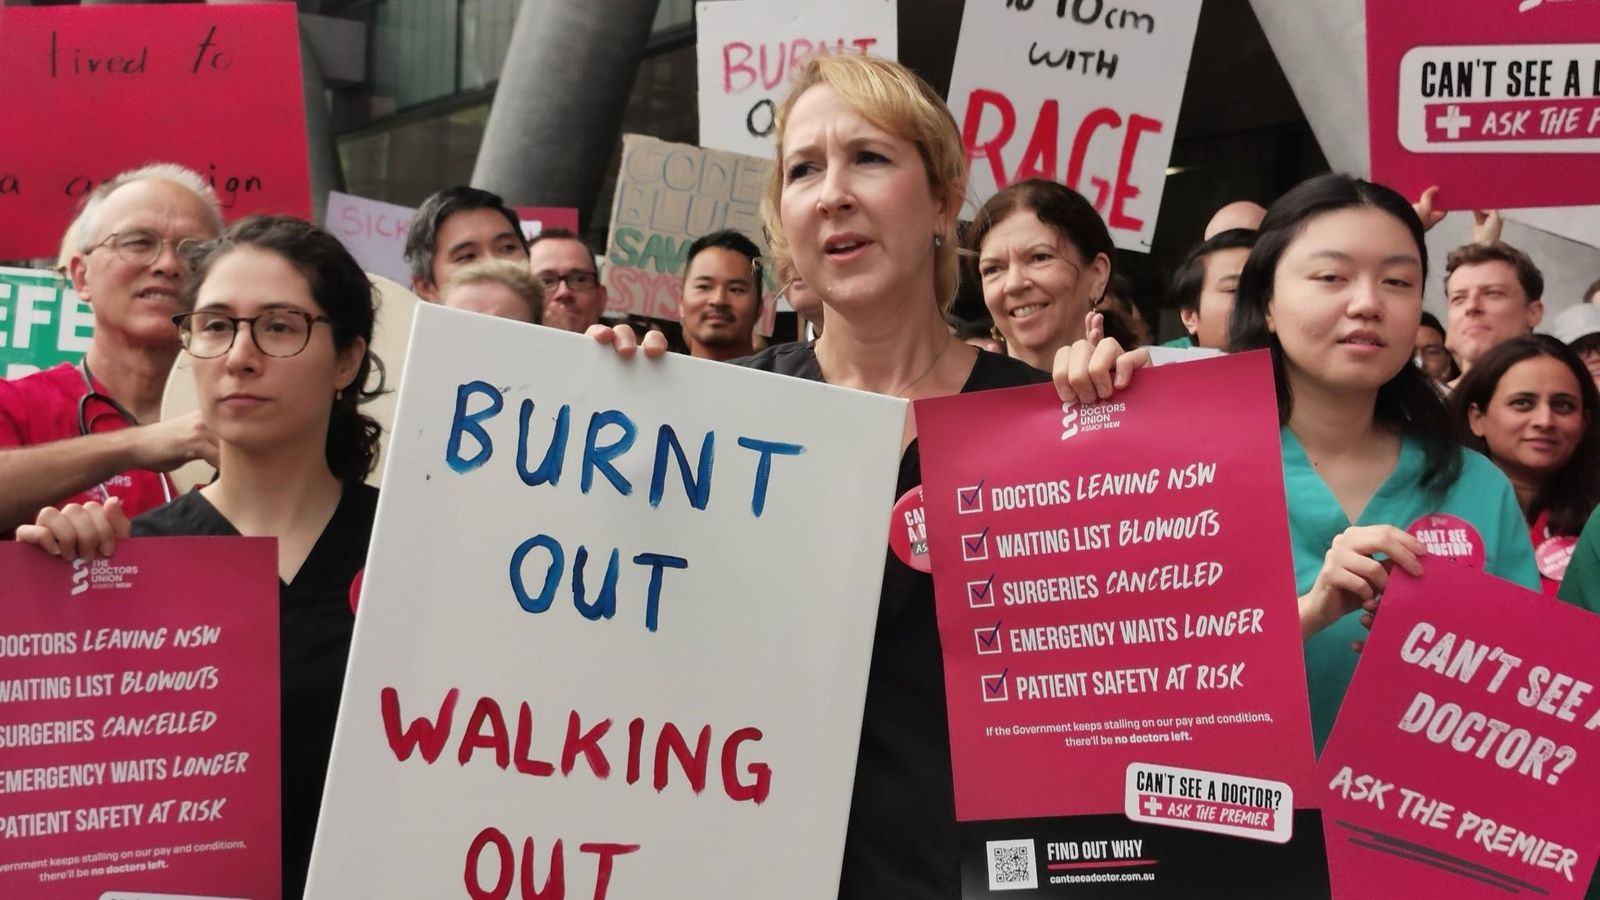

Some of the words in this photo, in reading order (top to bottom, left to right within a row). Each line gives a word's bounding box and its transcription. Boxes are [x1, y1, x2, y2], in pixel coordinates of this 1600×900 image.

[193, 25, 230, 73] to
[1029, 42, 1119, 79] WITH
[1421, 59, 1497, 97] CAN'T
[1506, 60, 1553, 97] SEE
[1564, 60, 1580, 96] A
[1481, 109, 1531, 136] ASK
[1540, 107, 1583, 135] THE
[626, 150, 766, 206] CODE
[962, 88, 1163, 232] RAGE
[616, 182, 757, 238] BLUE
[609, 227, 694, 274] SAV
[1080, 403, 1126, 417] DOCTORS
[1080, 414, 1110, 425] UNION
[446, 380, 806, 518] BURNT
[991, 481, 1071, 512] DOCTORS
[1076, 468, 1161, 501] LEAVING
[1168, 462, 1217, 491] NSW
[996, 531, 1070, 559] WAITING
[1074, 525, 1111, 551] LIST
[1119, 510, 1220, 547] BLOWOUTS
[1448, 529, 1467, 543] SEE
[91, 566, 138, 575] DOCTORS
[91, 575, 123, 583] UNION
[509, 534, 688, 632] OUT
[1003, 575, 1098, 606] SURGERIES
[1106, 562, 1224, 594] CANCELLED
[83, 627, 167, 652] LEAVING
[173, 625, 221, 647] NSW
[1009, 622, 1115, 653] EMERGENCY
[1120, 617, 1178, 645] WAITS
[1184, 609, 1265, 639] LONGER
[0, 676, 71, 702] WAITING
[76, 673, 114, 697] LIST
[120, 666, 218, 695] BLOWOUTS
[1016, 673, 1088, 700] PATIENT
[1092, 668, 1159, 695] SAFETY
[1165, 665, 1192, 690] AT
[1197, 663, 1246, 690] RISK
[1400, 621, 1522, 694] CAN'T
[1517, 666, 1593, 721] SEE
[103, 711, 217, 738] CANCELLED
[986, 727, 993, 737] If
[994, 725, 1011, 736] the
[1012, 720, 1072, 736] Government
[1074, 720, 1102, 734] keeps
[1104, 716, 1140, 732] stalling
[1142, 719, 1155, 728] on
[1157, 717, 1173, 727] our
[1175, 716, 1194, 729] pay
[1196, 713, 1214, 725] and
[1217, 711, 1274, 725] conditions,
[1065, 735, 1099, 747] there'll
[1101, 734, 1113, 744] be
[1115, 735, 1128, 744] no
[1130, 731, 1169, 743] doctors
[1171, 730, 1192, 742] left.
[1397, 692, 1577, 785] DOCTOR?
[381, 686, 772, 805] WALKING
[111, 758, 167, 784] WAITS
[173, 752, 249, 778] LONGER
[1136, 770, 1176, 796] CAN'T
[1180, 776, 1202, 799] SEE
[1207, 781, 1216, 801] A
[1221, 783, 1282, 811] DOCTOR?
[76, 804, 144, 832] SAFETY
[148, 800, 175, 824] AT
[178, 798, 226, 823] RISK
[1167, 802, 1191, 818] ASK
[1196, 804, 1216, 821] THE
[1220, 807, 1269, 827] PREMIER
[1329, 765, 1394, 810] ASK
[1397, 788, 1456, 829] THE
[1456, 811, 1578, 882] PREMIER
[0, 860, 47, 872] vernment
[50, 857, 80, 869] keeps
[82, 852, 119, 864] stalling
[120, 851, 134, 859] on
[135, 849, 152, 857] our
[154, 847, 171, 858] pay
[173, 844, 192, 854] and
[193, 840, 247, 853] conditions,
[464, 826, 641, 900] OUT
[1047, 842, 1079, 861] FIND
[1082, 841, 1107, 859] OUT
[1111, 839, 1143, 859] WHY
[76, 868, 89, 878] be
[91, 867, 105, 876] no
[106, 861, 146, 875] doctors
[147, 860, 169, 870] left.
[1050, 871, 1155, 884] cantseeadoctor.com.au
